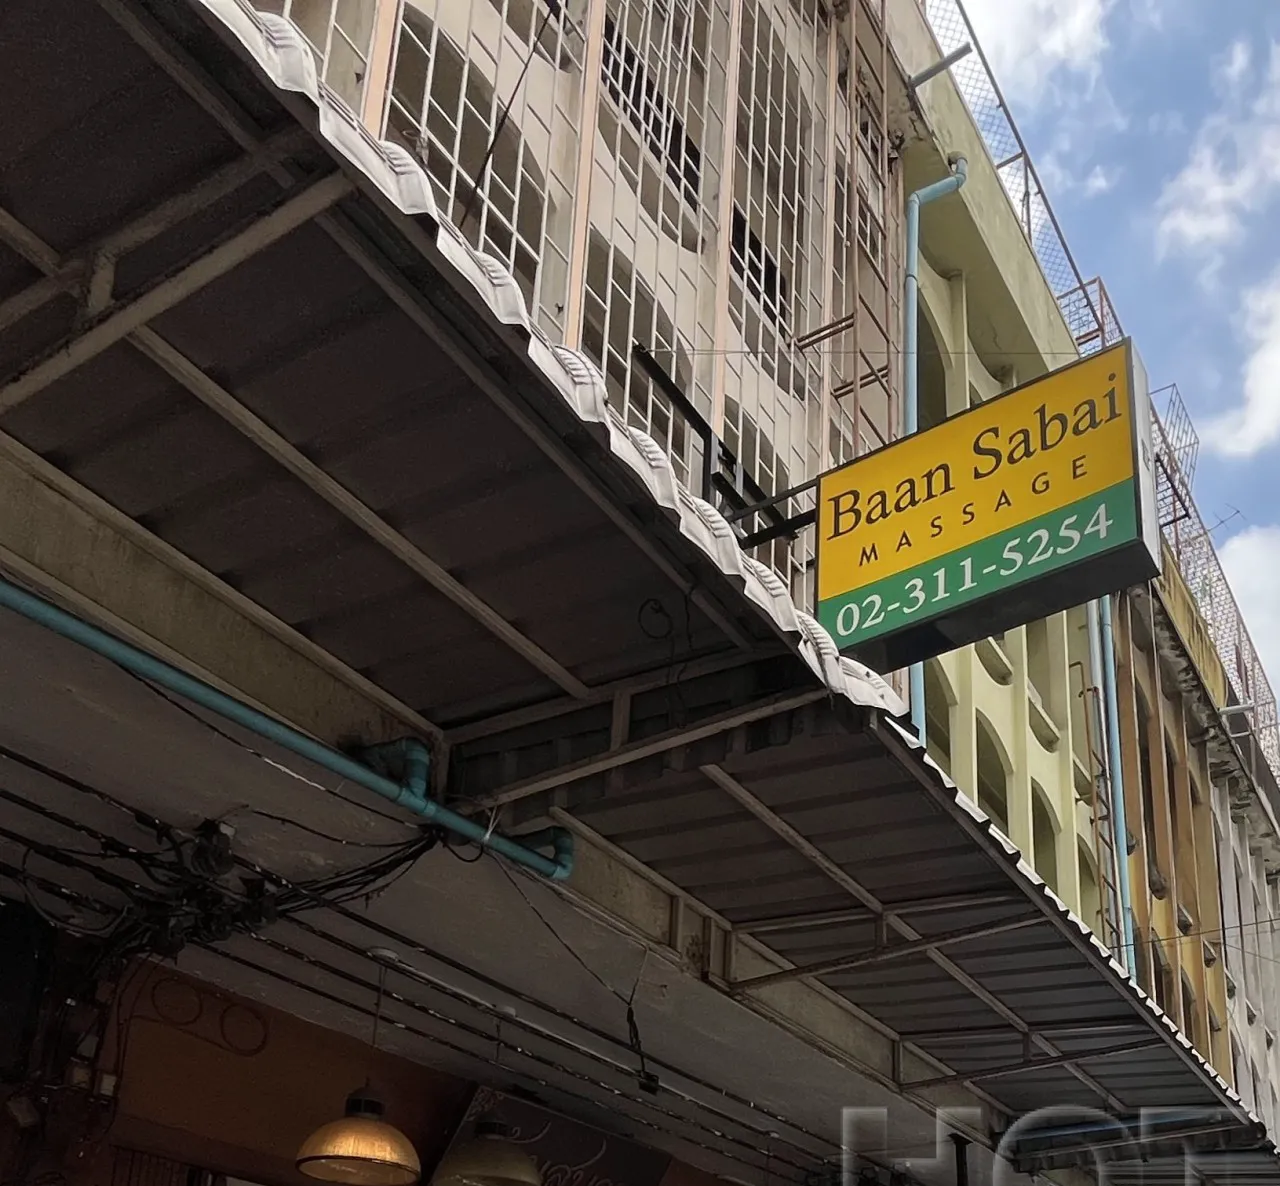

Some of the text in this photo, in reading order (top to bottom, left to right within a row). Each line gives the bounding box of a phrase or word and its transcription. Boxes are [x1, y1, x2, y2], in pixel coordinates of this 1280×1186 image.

[826, 372, 1122, 540] Baan Sabai
[859, 455, 1087, 566] MASSAGE
[836, 504, 1112, 636] 02-311-5254
